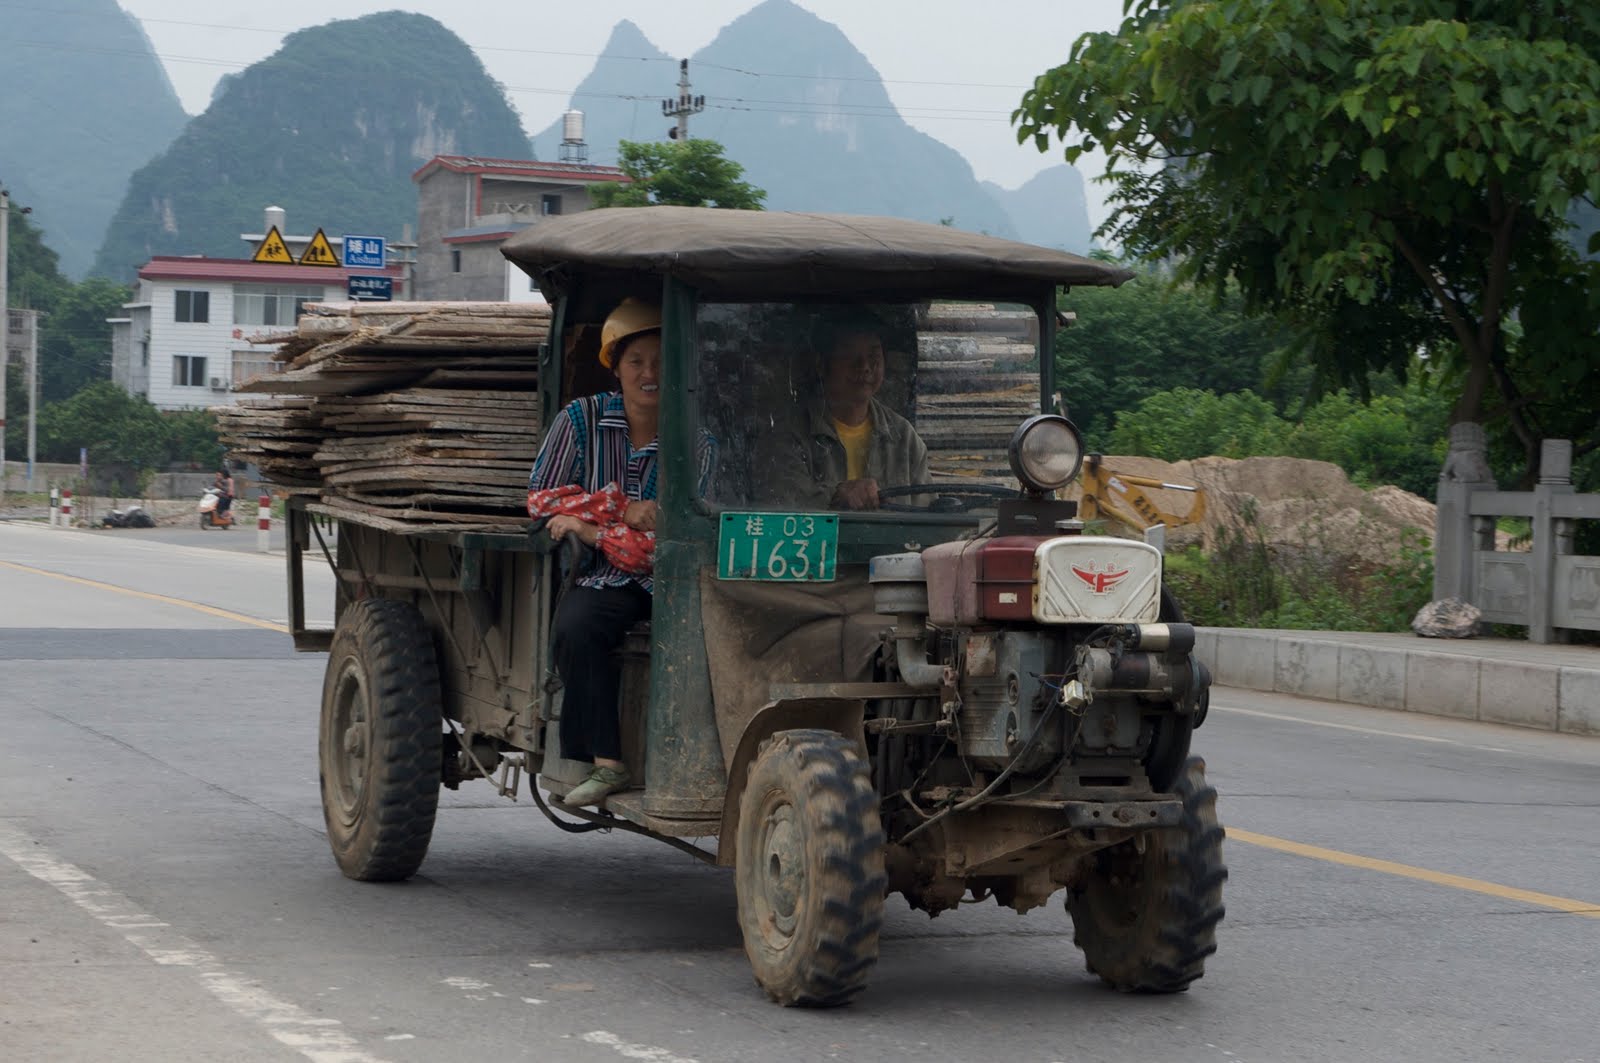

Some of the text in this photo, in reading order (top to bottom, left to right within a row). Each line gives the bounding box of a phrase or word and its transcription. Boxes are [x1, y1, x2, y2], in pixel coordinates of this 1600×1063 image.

[745, 516, 815, 537] 桂 03
[727, 538, 827, 578] 11631
